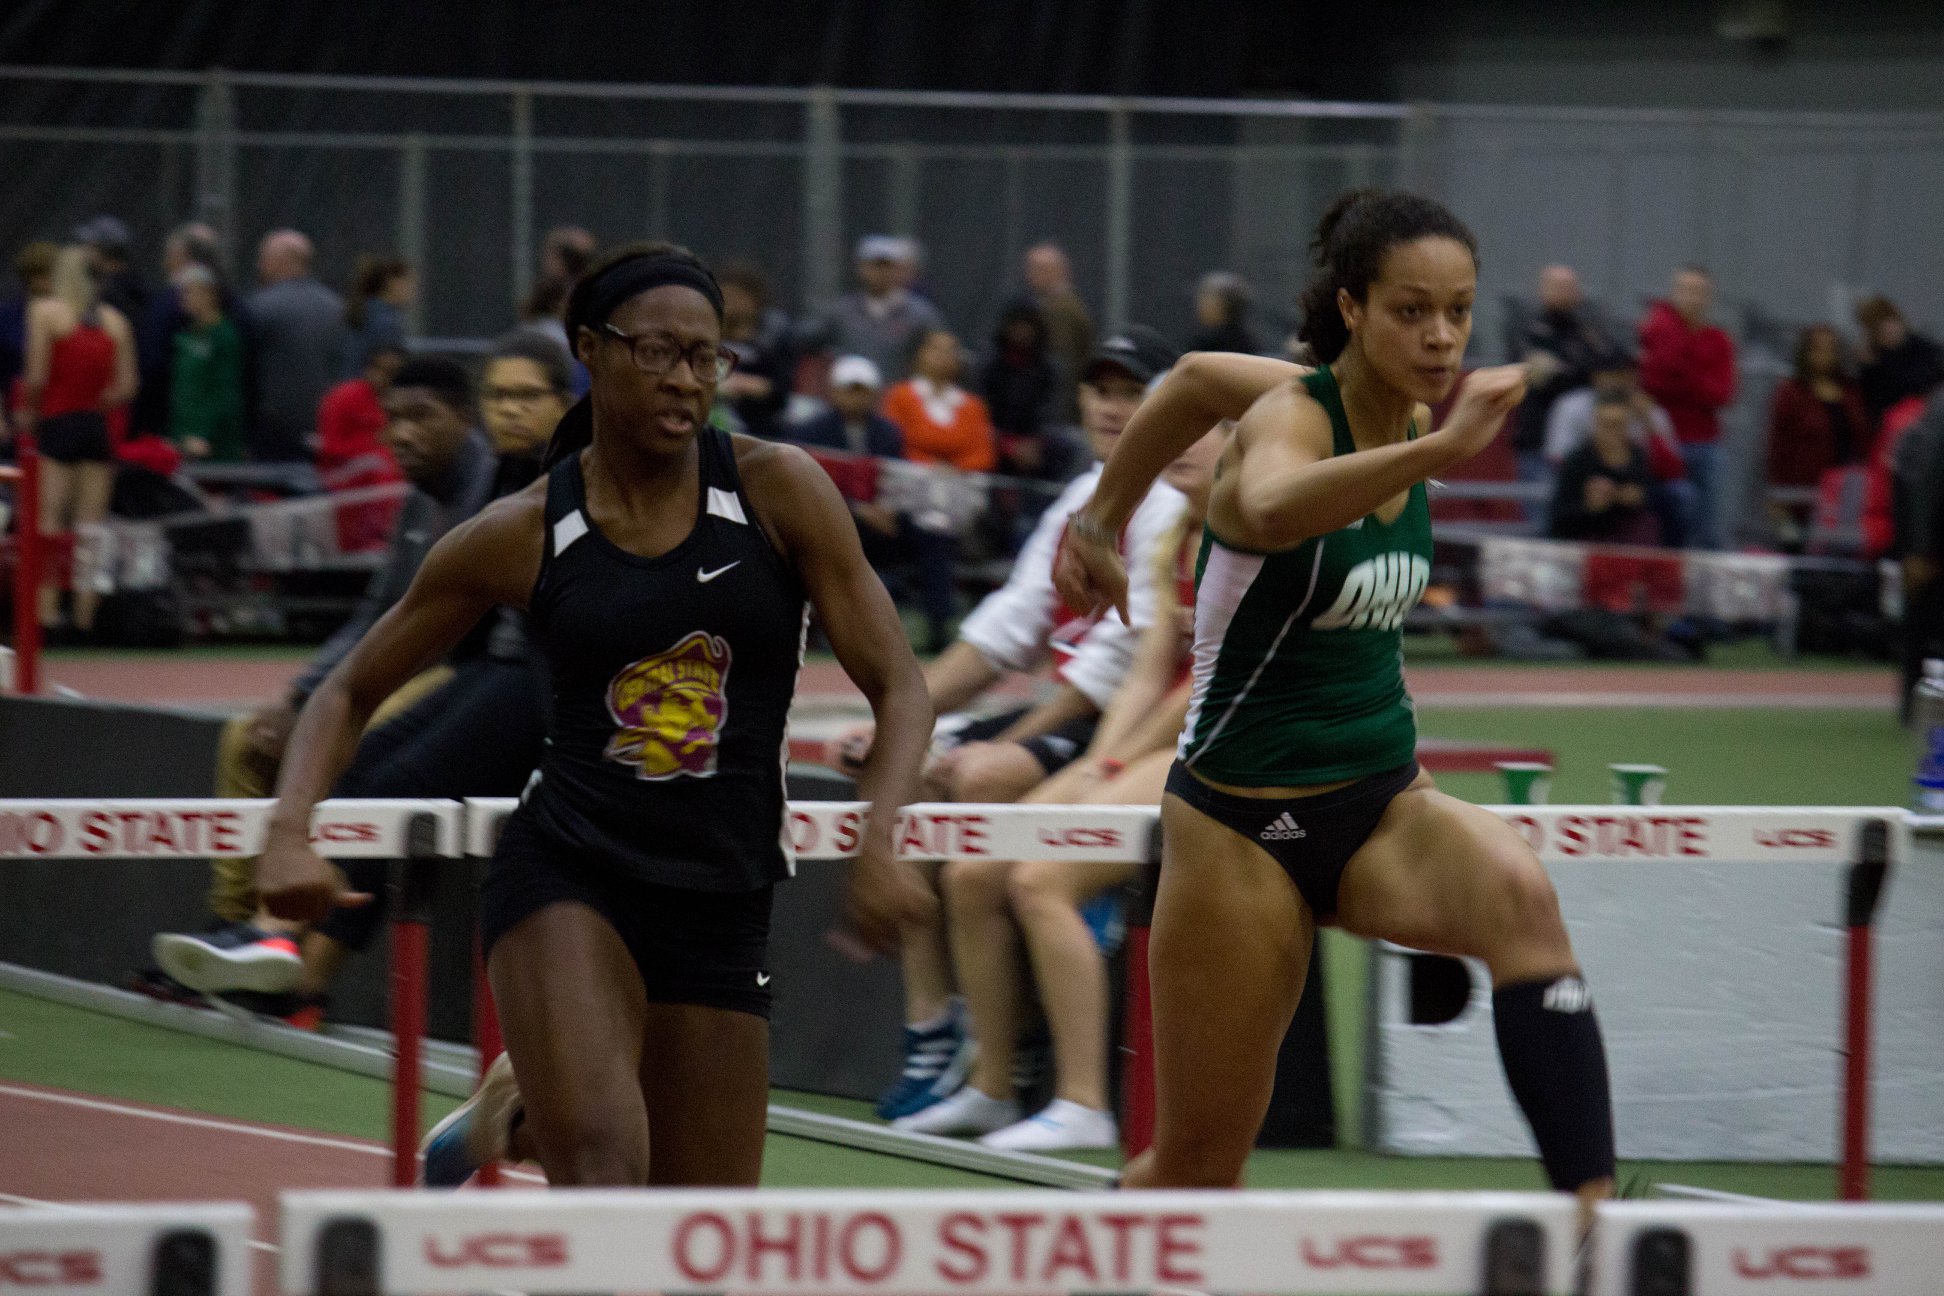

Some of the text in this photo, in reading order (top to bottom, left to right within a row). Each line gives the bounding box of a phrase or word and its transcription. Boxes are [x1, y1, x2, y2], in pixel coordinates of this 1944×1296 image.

[1310, 550, 1431, 633] OHIO
[78, 811, 242, 855] STATE
[1260, 829, 1307, 840] adidas
[1555, 814, 1709, 858] STATE
[423, 1232, 569, 1268] UCS
[672, 1210, 1207, 1284] OHIO STATE
[1301, 1234, 1438, 1271] UCS
[1732, 1245, 1871, 1281] UCS
